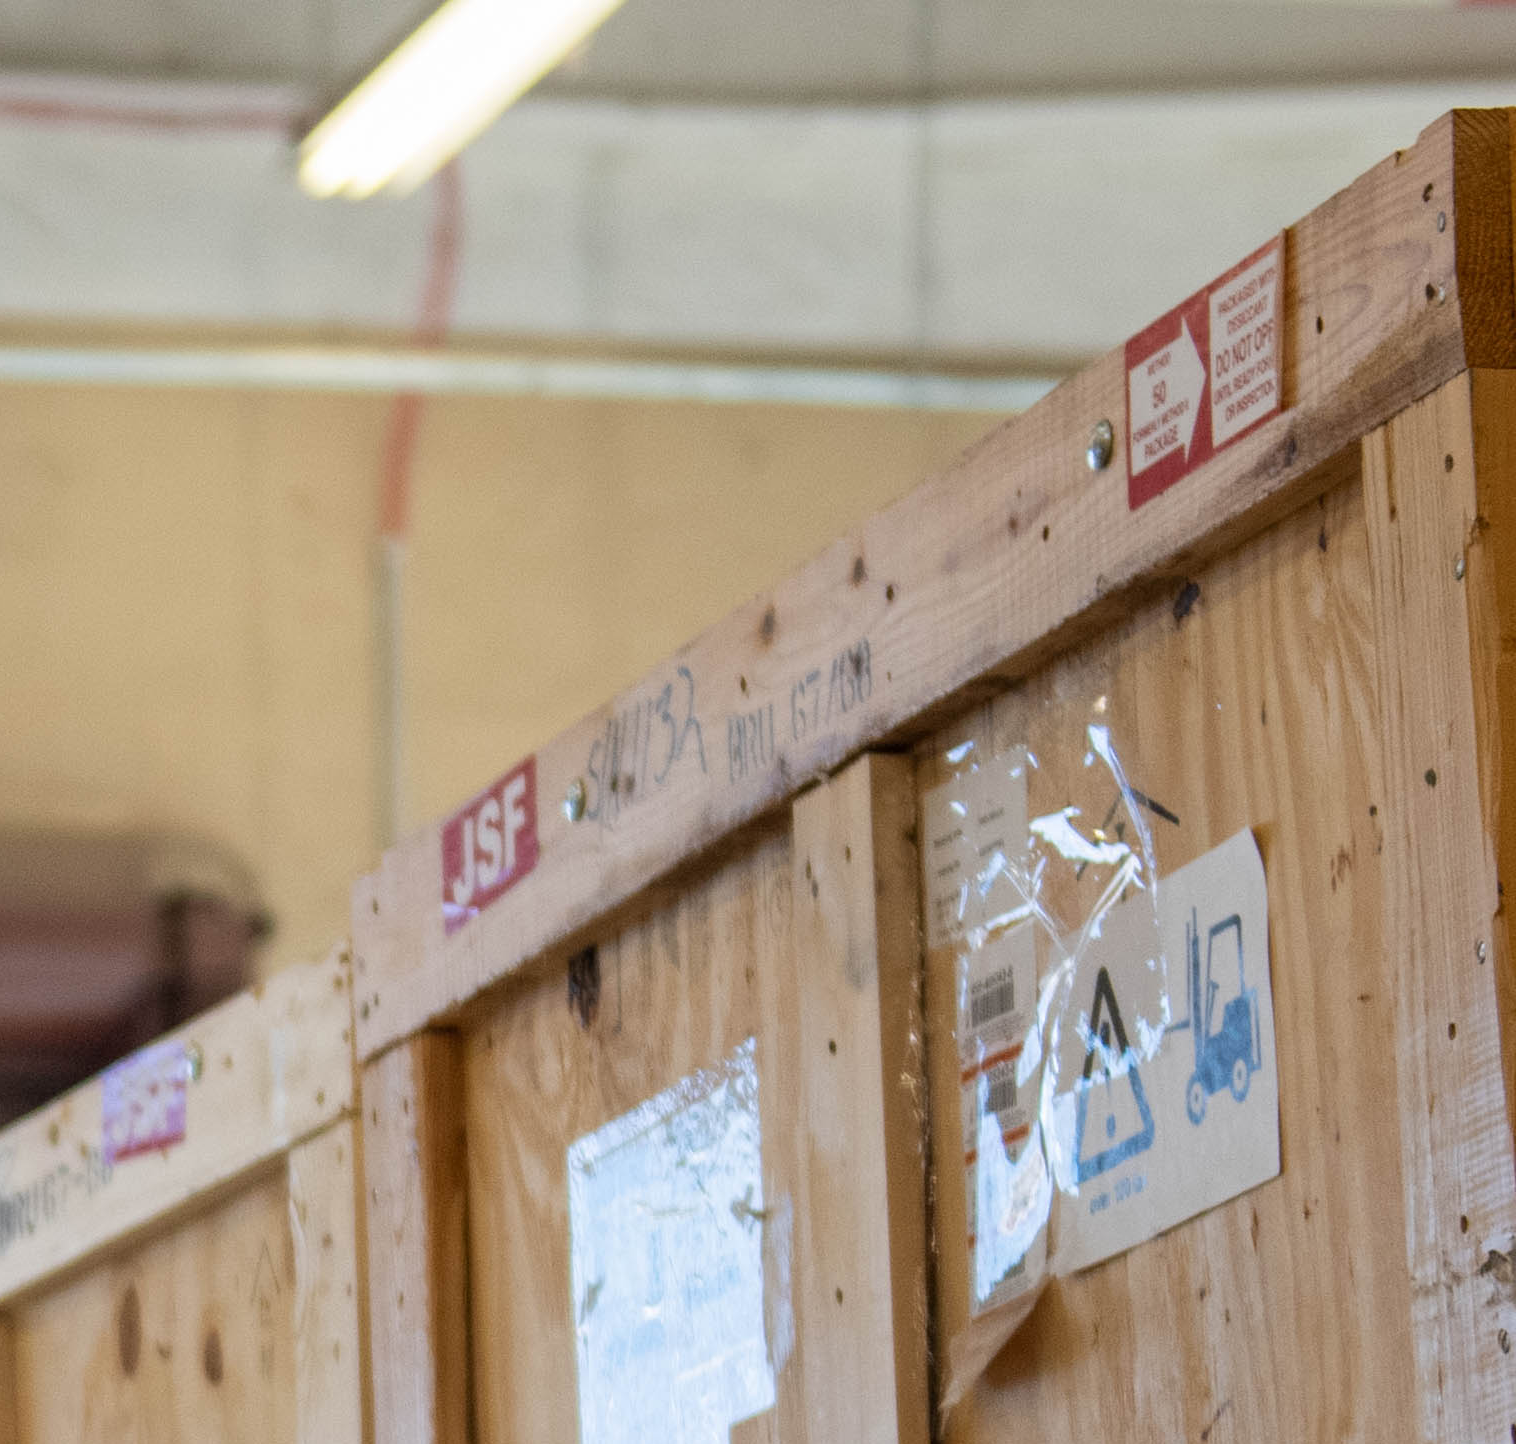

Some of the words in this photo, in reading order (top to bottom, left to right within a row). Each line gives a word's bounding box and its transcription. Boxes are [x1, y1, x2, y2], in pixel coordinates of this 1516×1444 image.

[1216, 348, 1231, 378] DO
[1232, 334, 1254, 364] NOT
[453, 774, 526, 907] JSF
